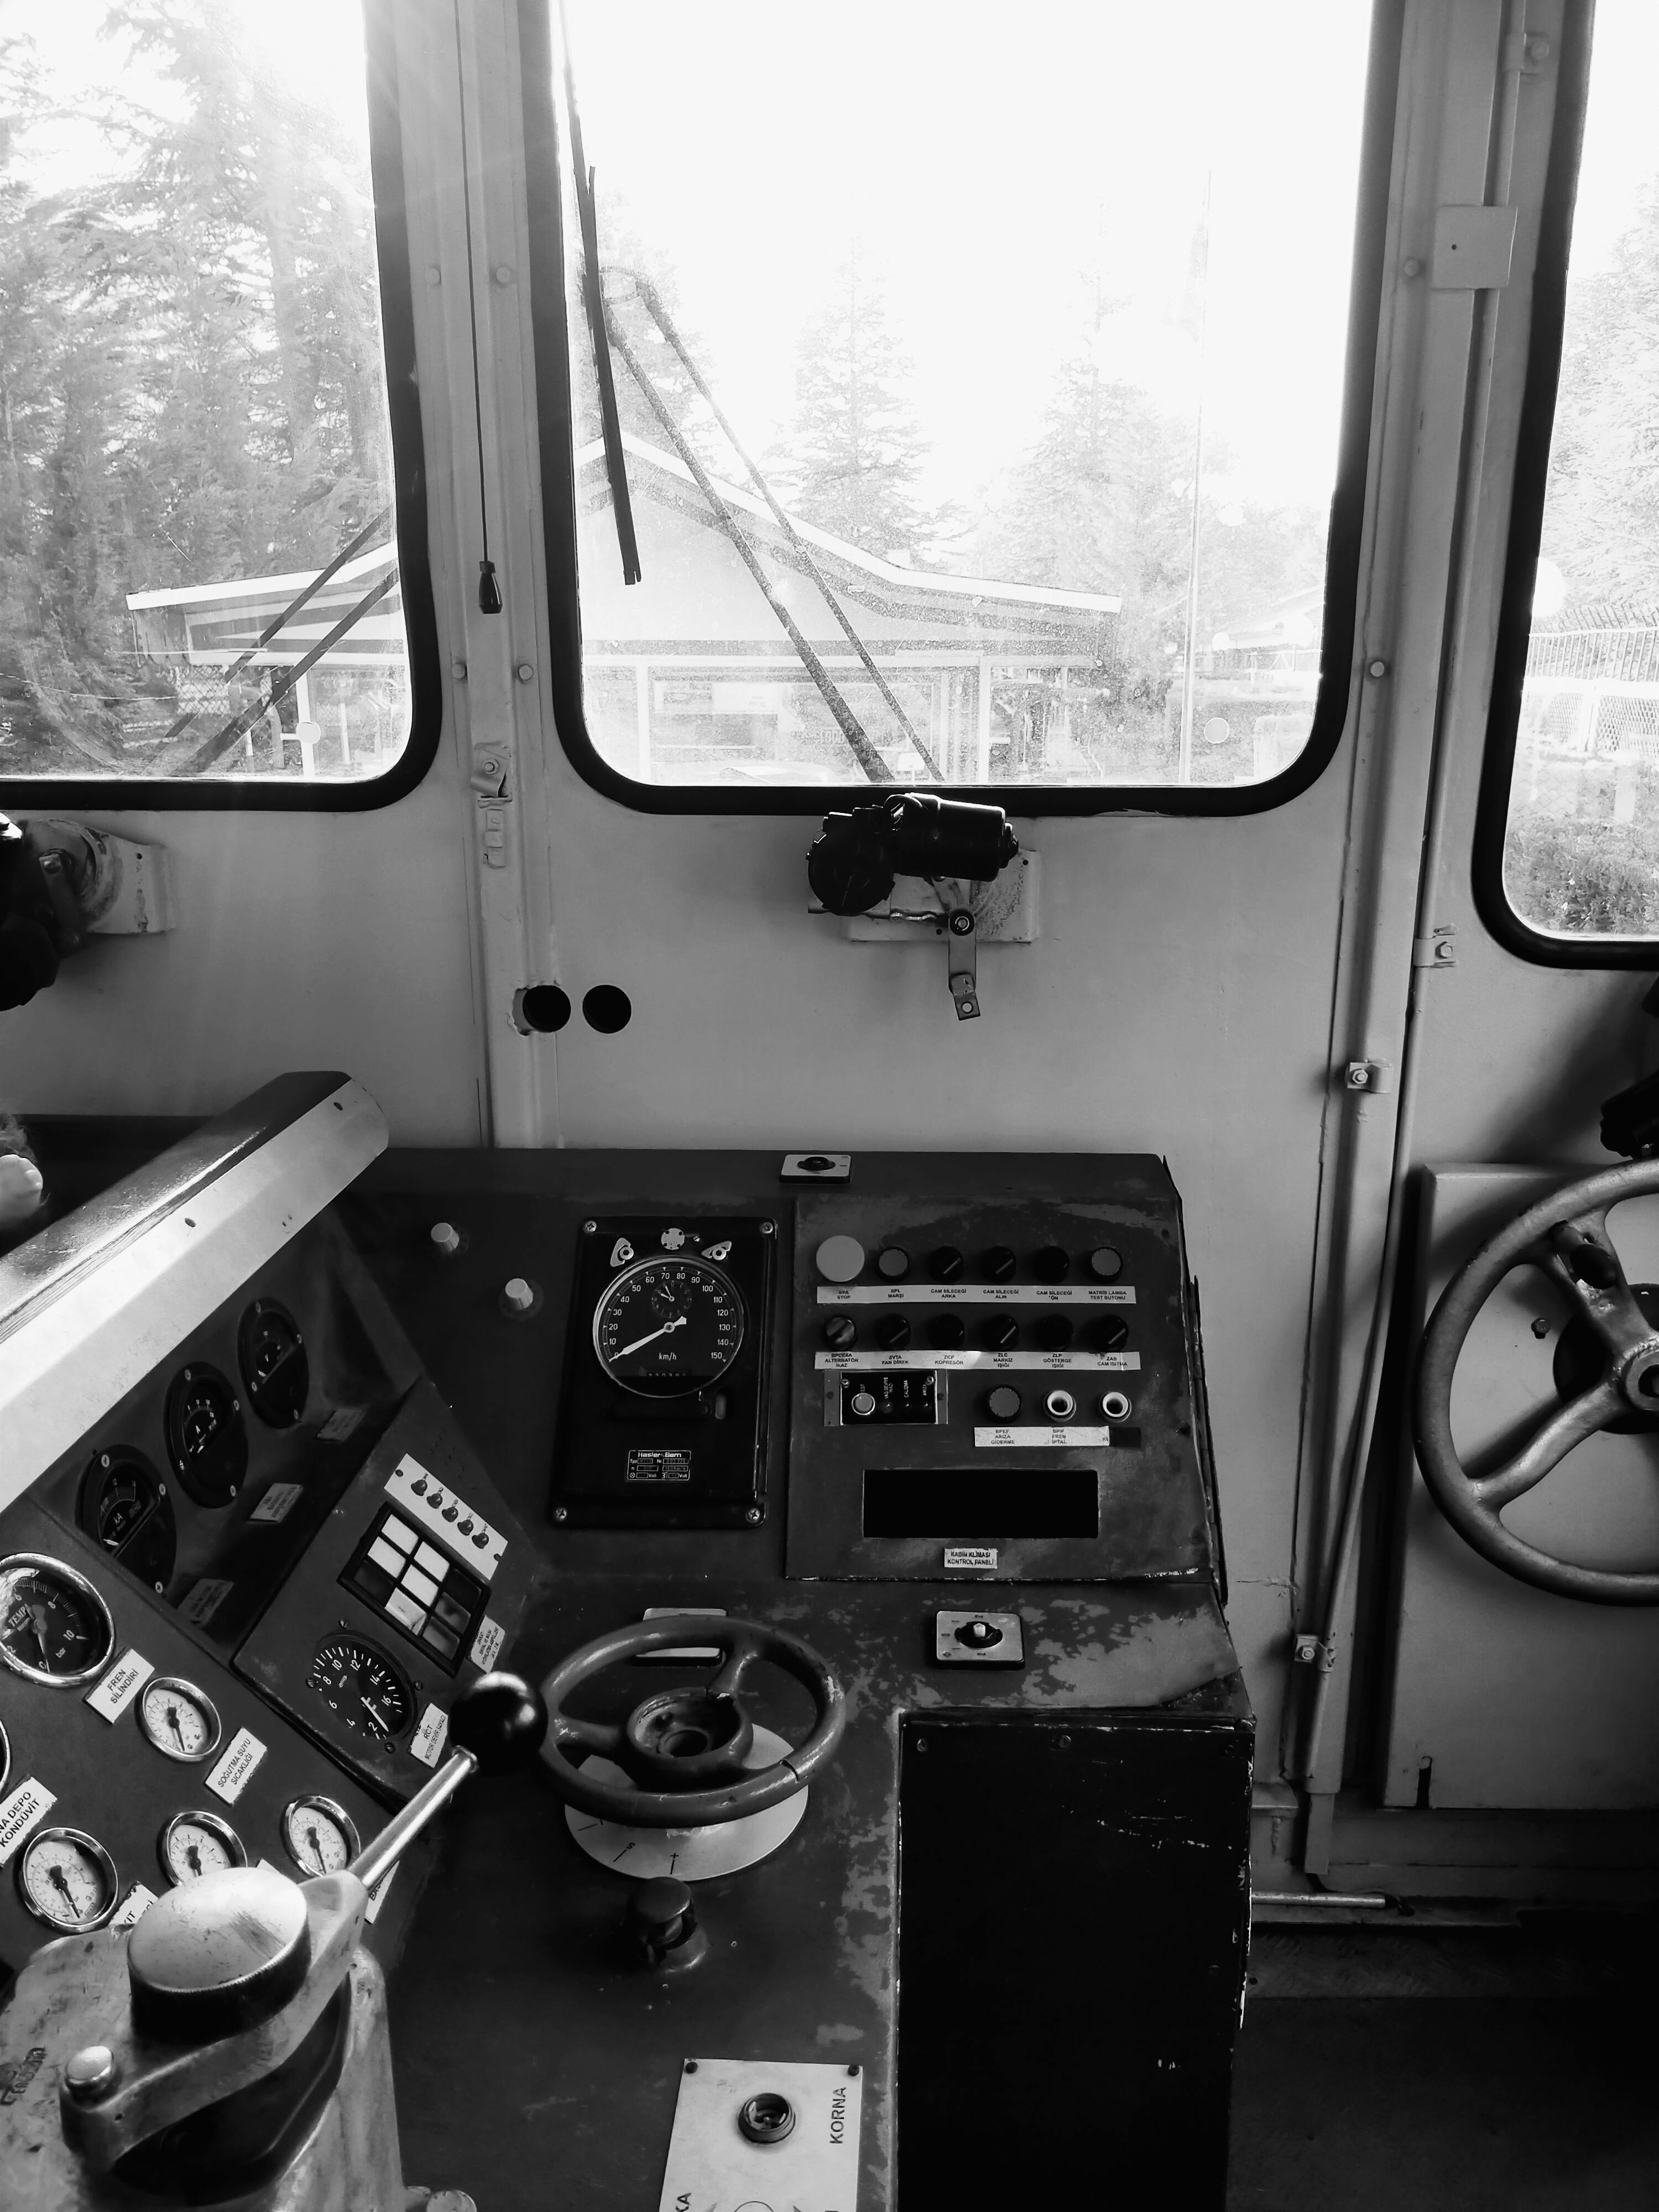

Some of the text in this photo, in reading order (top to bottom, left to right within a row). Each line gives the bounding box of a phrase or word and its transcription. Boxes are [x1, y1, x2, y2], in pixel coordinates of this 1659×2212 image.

[659, 1352, 677, 1360] km/h
[48, 1601, 56, 1609] 8
[62, 1629, 75, 1641] 10
[7, 1645, 16, 1653] 2
[55, 1647, 66, 1658] bar
[332, 1659, 342, 1671] 10
[350, 1660, 361, 1671] 12
[107, 1668, 126, 1692] FREN
[322, 1676, 332, 1685] 8
[370, 1674, 380, 1685] 14
[328, 1699, 337, 1709] 6
[381, 1695, 392, 1706] 16
[368, 1721, 378, 1731] 2
[424, 1724, 433, 1740] RCT
[424, 1743, 435, 1760] MOTOR
[217, 1738, 251, 1788] SOĞUTMA SUYU
[231, 1752, 253, 1785] SICAKLIĞI
[7, 1792, 31, 1819] DEPO
[0, 1798, 40, 1848] KONDÜVİT
[830, 2086, 847, 2144] KORNA
